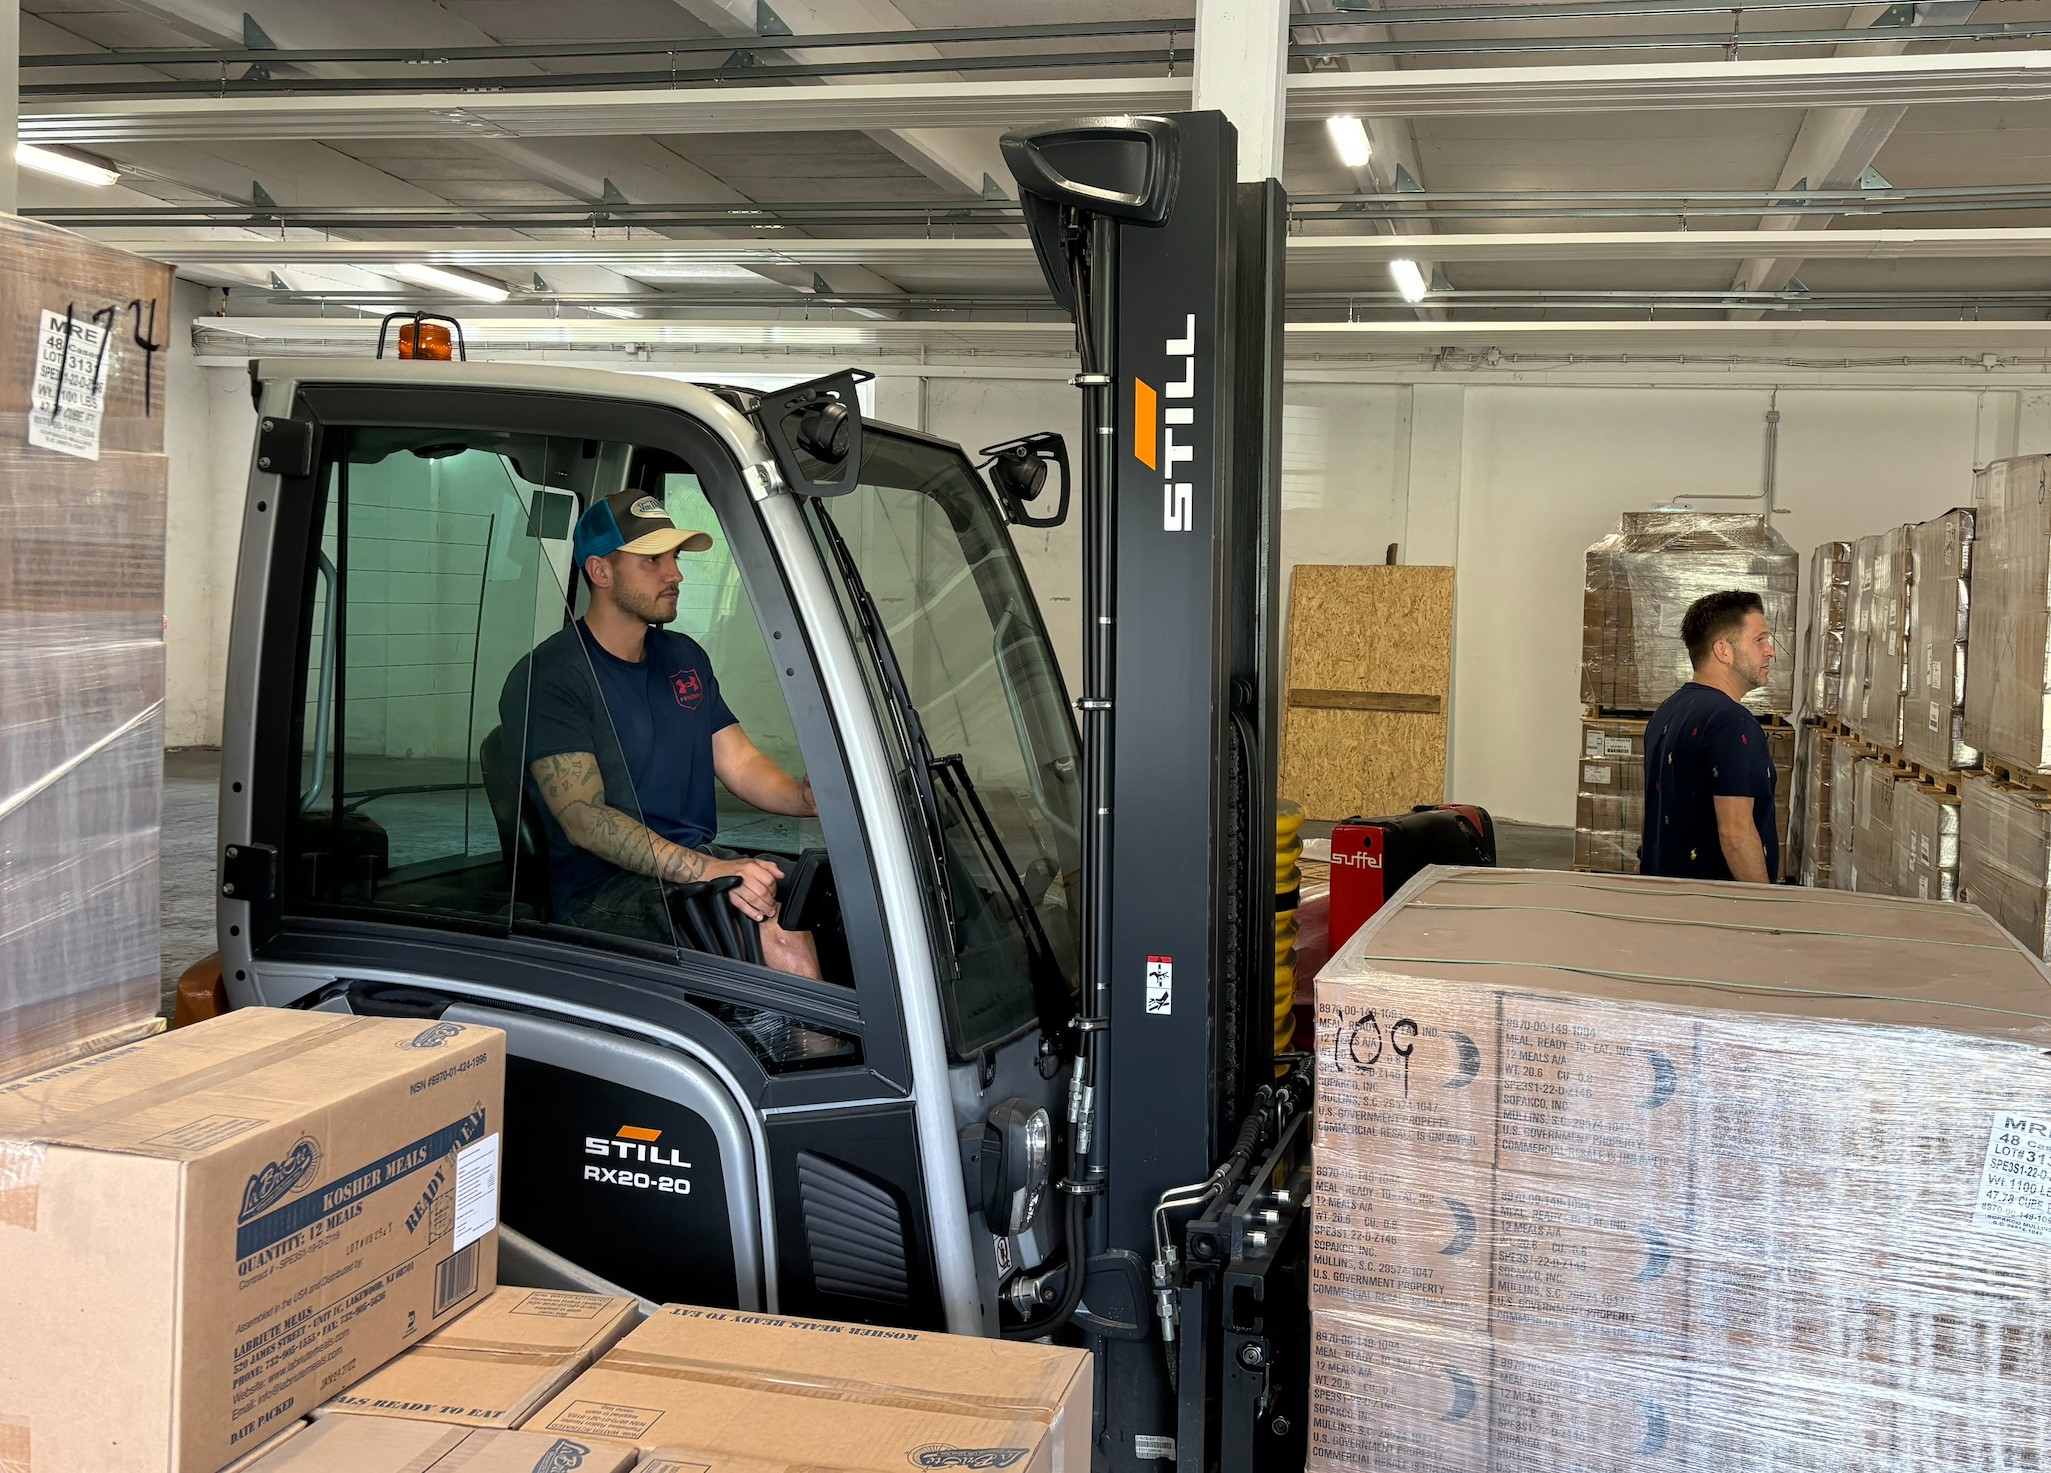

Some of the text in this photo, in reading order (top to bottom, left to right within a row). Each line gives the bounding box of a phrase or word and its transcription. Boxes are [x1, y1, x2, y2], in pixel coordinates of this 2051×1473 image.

[50, 317, 97, 345] MRE
[46, 336, 63, 350] 48
[1164, 313, 1195, 531] STILL
[1330, 851, 1382, 869] suffel
[1362, 1037, 1376, 1047] A/A
[1506, 1034, 1567, 1049] MEAL, READY
[1506, 1049, 1567, 1065] 12 MEALS A/A
[1505, 1064, 1543, 1078] WT. 20.6
[410, 1080, 426, 1095] NSN
[1503, 1094, 1548, 1109] SOPAKCO,
[1319, 1108, 1334, 1118] U.S.
[1503, 1110, 1548, 1124] MULLINS,
[1319, 1121, 1378, 1136] COMMERCIAL
[1503, 1125, 1520, 1136] U.S.
[1523, 1127, 1589, 1143] GOVERNMENT
[2005, 1116, 2051, 1138] MR
[1502, 1139, 1565, 1155] COMMERCIAL
[1999, 1133, 2020, 1146] 48
[585, 1136, 692, 1168] STILL
[405, 1166, 446, 1234] READY
[445, 1140, 463, 1169] TO
[461, 1100, 485, 1142] EAT
[323, 1145, 427, 1212] KOSHER MEALS
[584, 1164, 691, 1195] RX20-20
[2010, 1178, 2037, 1195] 1100
[1345, 1184, 1374, 1197] READY
[1328, 1197, 1373, 1211] MEALS A/A
[1364, 1216, 1378, 1227] CU.
[1501, 1221, 1511, 1231] 12
[1514, 1223, 1544, 1235] MEALS
[1987, 1214, 2022, 1226] SOPAKCO
[238, 1202, 363, 1276] QUANTITY: 12 MEALS
[1552, 1242, 1565, 1253] CU.
[1359, 1245, 1377, 1256] INC.
[1314, 1254, 1355, 1269] MULLINS,
[1358, 1260, 1376, 1271] S.C.
[1313, 1269, 1445, 1294] U.S. GOVERNMENT PROPERTY
[1498, 1266, 1564, 1283] SOPAKCO, INC.
[1313, 1283, 1370, 1299] COMMERCIAL
[1498, 1281, 1564, 1298] MULLINS, S.C.
[235, 1308, 274, 1335] Assembled
[293, 1287, 308, 1302] USA
[1497, 1296, 1636, 1322] U.S. GOVERNMENT PROPERTY
[233, 1306, 314, 1359] LABRIUTE MEALS
[669, 1308, 919, 1342] KOSHER MEALS READY TO EAT
[250, 1345, 276, 1364] JAMES
[277, 1325, 307, 1349] STREET
[1345, 1349, 1374, 1362] READY
[1315, 1361, 1324, 1371] 12
[1328, 1362, 1356, 1375] MEALS
[233, 1366, 263, 1389] PHONE:
[1314, 1375, 1328, 1386] WT.
[233, 1380, 267, 1404] Website:
[232, 1400, 257, 1421] Email:
[372, 1399, 506, 1419] READY TO EAT
[1313, 1403, 1355, 1418] SOPAKCO,
[230, 1397, 295, 1445] DATE PACKED
[1313, 1418, 1356, 1432] MULLINS,
[1313, 1432, 1330, 1444] U.S.
[1333, 1435, 1394, 1453] GOVERNMENT
[1312, 1447, 1372, 1464] COMMERCIAL
